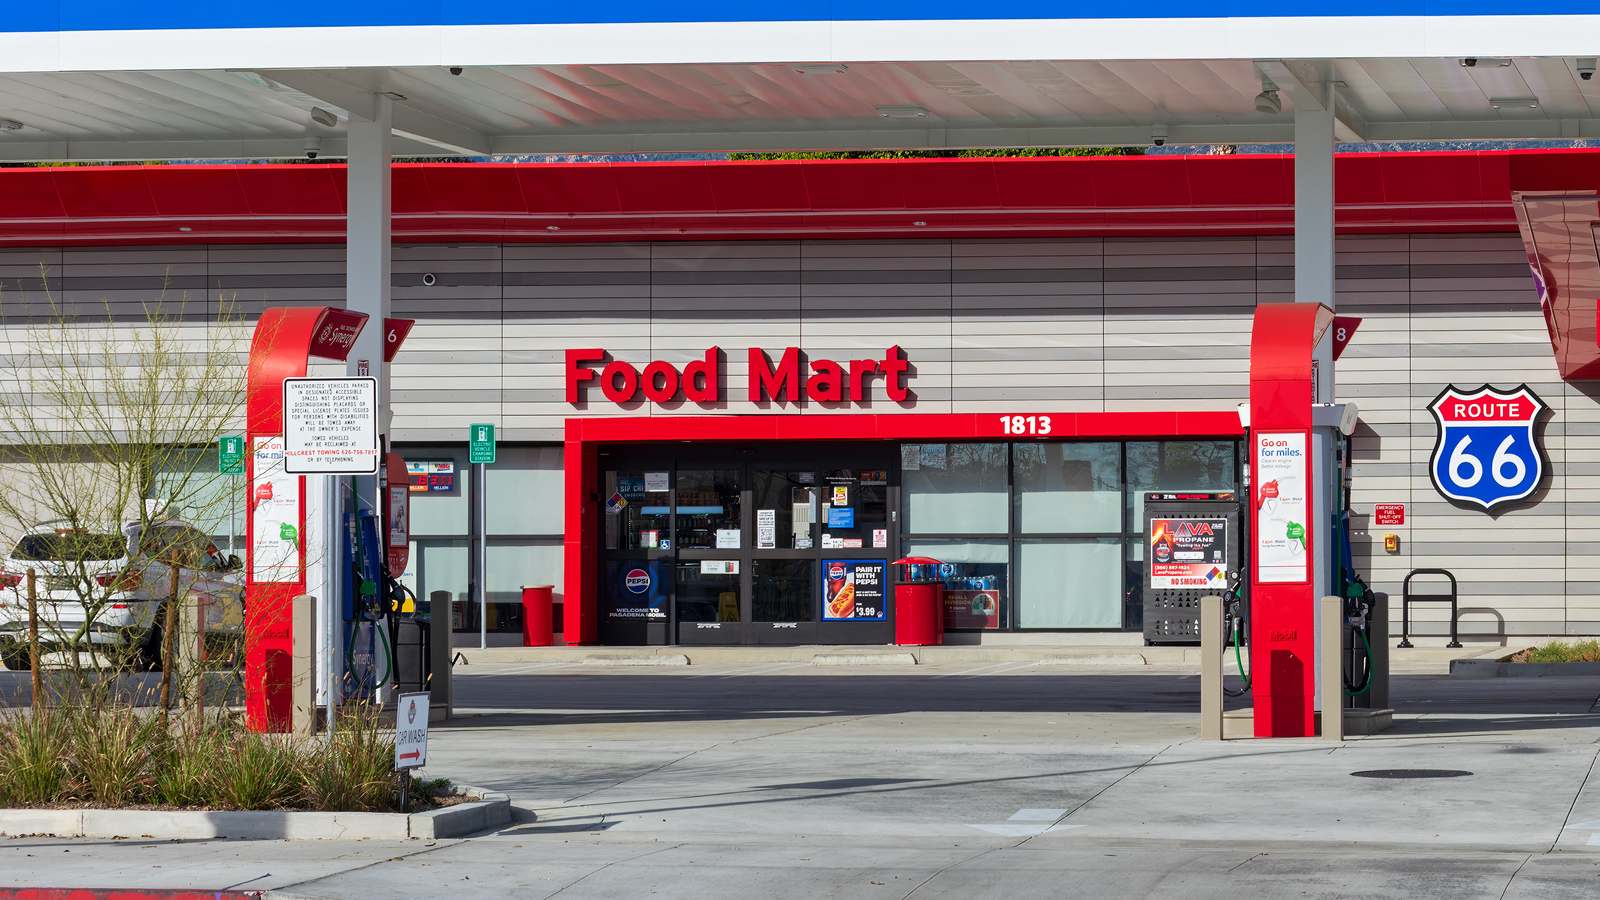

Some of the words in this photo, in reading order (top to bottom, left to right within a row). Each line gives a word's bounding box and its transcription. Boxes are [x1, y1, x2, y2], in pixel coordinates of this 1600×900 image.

[388, 329, 396, 342] 6
[1336, 328, 1346, 342] 8
[565, 345, 719, 403] Food
[748, 344, 908, 402] Mart
[1454, 403, 1520, 418] ROUTE
[1000, 416, 1051, 434] 1813
[257, 441, 269, 450] Go
[1262, 439, 1274, 447] Go
[256, 451, 268, 459] for
[271, 451, 284, 459] mil
[1262, 448, 1274, 456] for
[1276, 448, 1302, 456] miles.
[1449, 434, 1526, 488] 66
[1163, 522, 1214, 537] LAVA
[856, 607, 875, 616] $3.99
[408, 729, 426, 744] WASH
